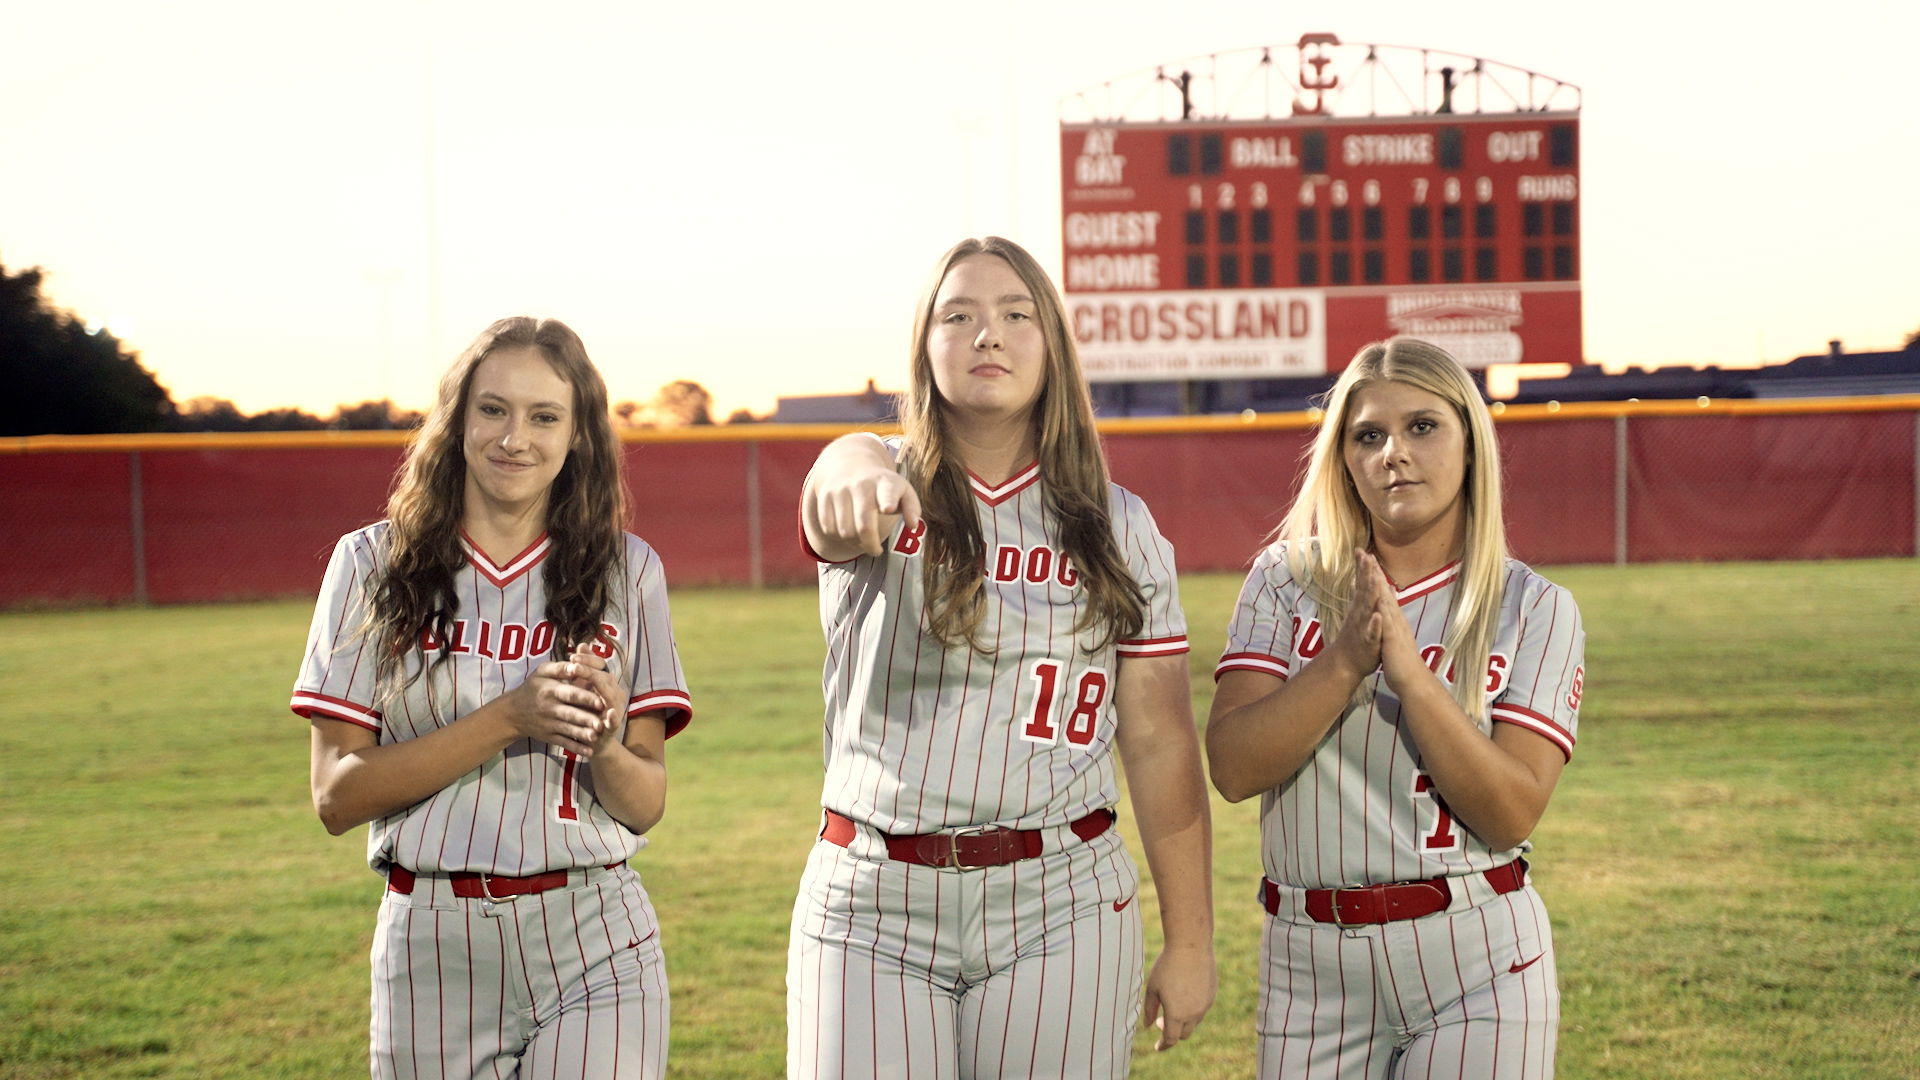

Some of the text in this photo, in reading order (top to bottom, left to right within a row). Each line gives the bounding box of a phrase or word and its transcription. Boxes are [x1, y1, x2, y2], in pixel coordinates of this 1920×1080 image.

[1231, 138, 1297, 168] BALL
[1343, 134, 1434, 166] STRIKE
[1488, 131, 1542, 162] OUT
[1076, 154, 1126, 184] BAT
[1188, 184, 1203, 207] 1
[1218, 183, 1235, 209] 2
[1251, 182, 1268, 208] 3
[1413, 178, 1429, 203] 7
[1476, 176, 1493, 202] 9
[1517, 175, 1577, 201] RUNS
[1066, 212, 1161, 248] GUEST
[1068, 254, 1160, 289] HOME
[1073, 299, 1310, 343] CROSSLAND
[891, 517, 1090, 588] BDOG
[1020, 657, 1108, 750] 18
